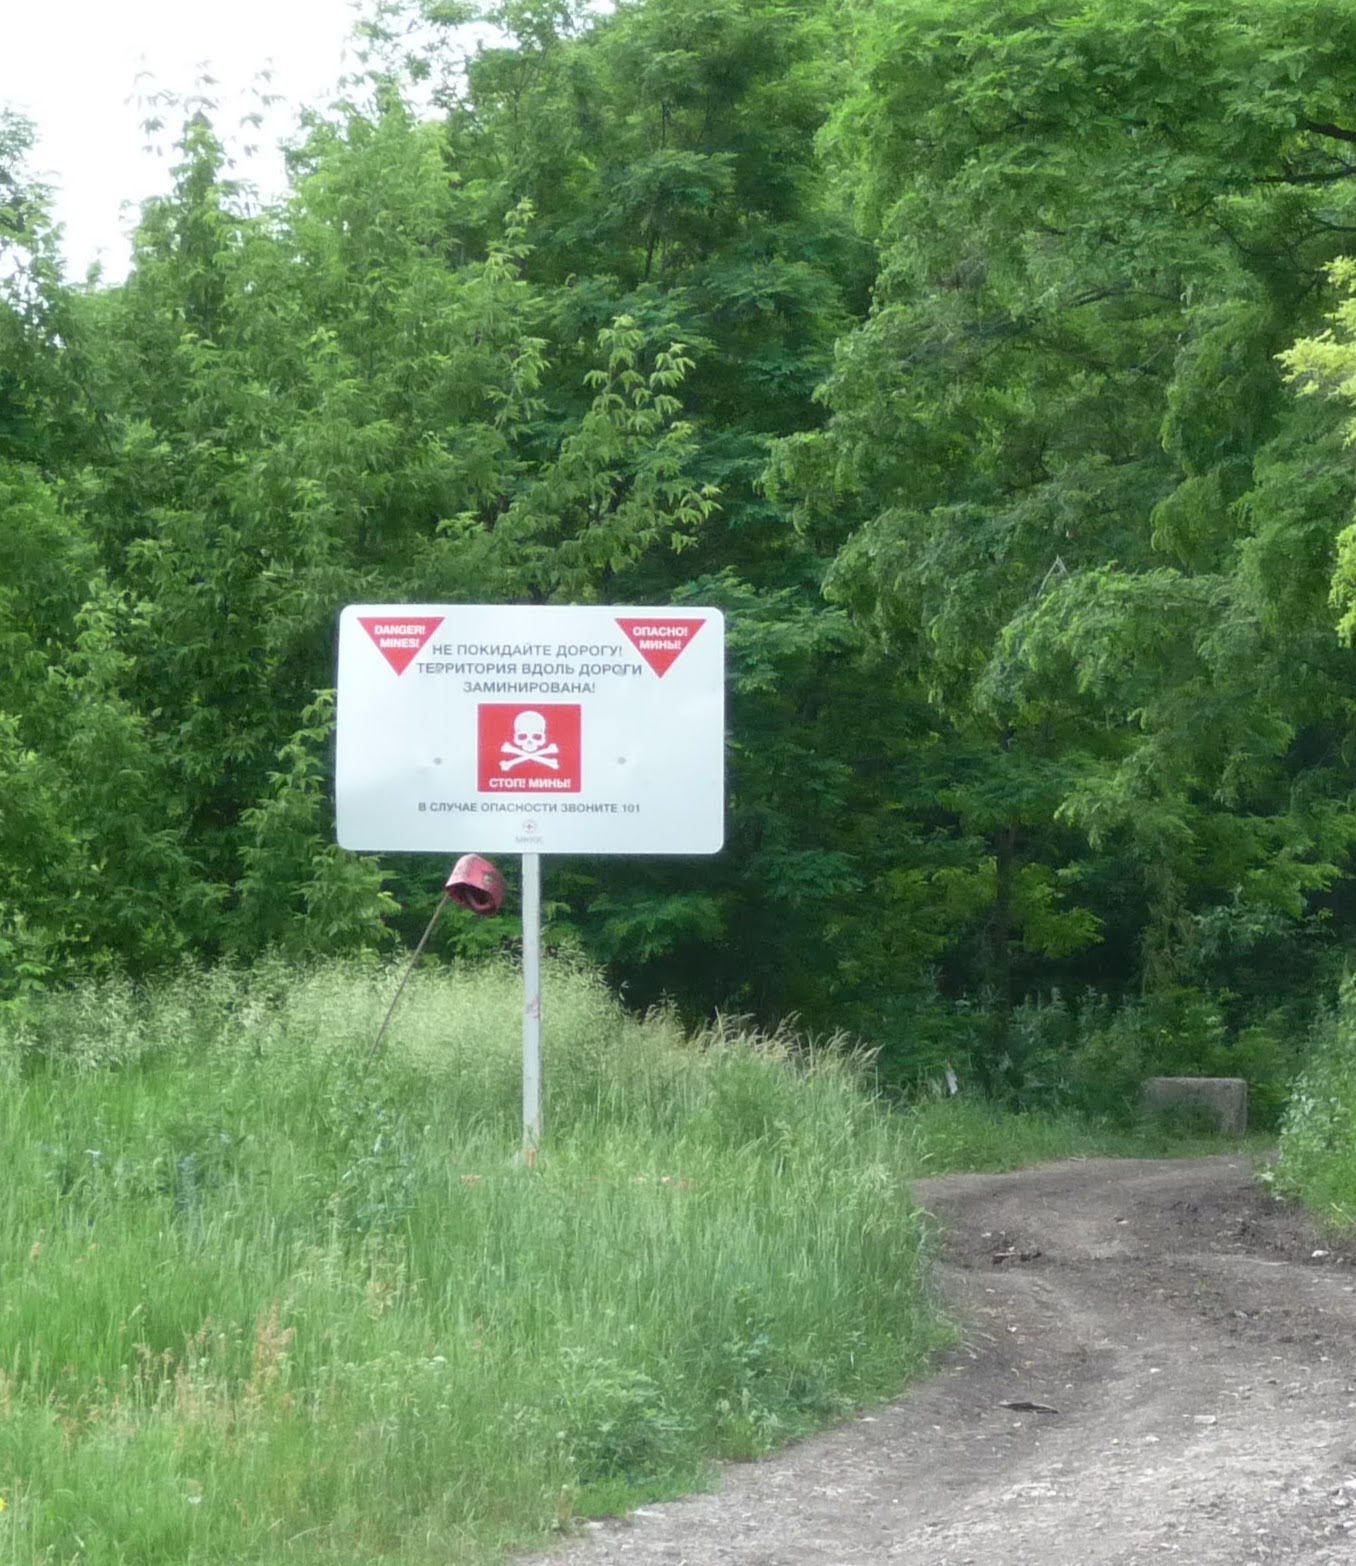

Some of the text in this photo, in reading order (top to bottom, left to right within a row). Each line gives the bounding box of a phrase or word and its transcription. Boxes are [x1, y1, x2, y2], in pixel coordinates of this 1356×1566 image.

[374, 624, 426, 636] DANGER!
[632, 625, 689, 637] ОПАСНО!
[380, 638, 420, 649] MINES!
[639, 638, 682, 650] МИНЫ!
[432, 642, 623, 658] НЕ ПОКИДАЙТЕ ДОРОГУ!
[417, 663, 642, 677] ТЕРРИТОРИЯ ВДОЛЬ ДОРОГИ
[463, 681, 596, 694] ЗАМИНИРОВАНА!
[488, 777, 571, 789] СТОП! МИНЫ!
[418, 802, 641, 813] В СЛУЧАЕ ОПАСНОСТИ ЗВОНИТЕ 101
